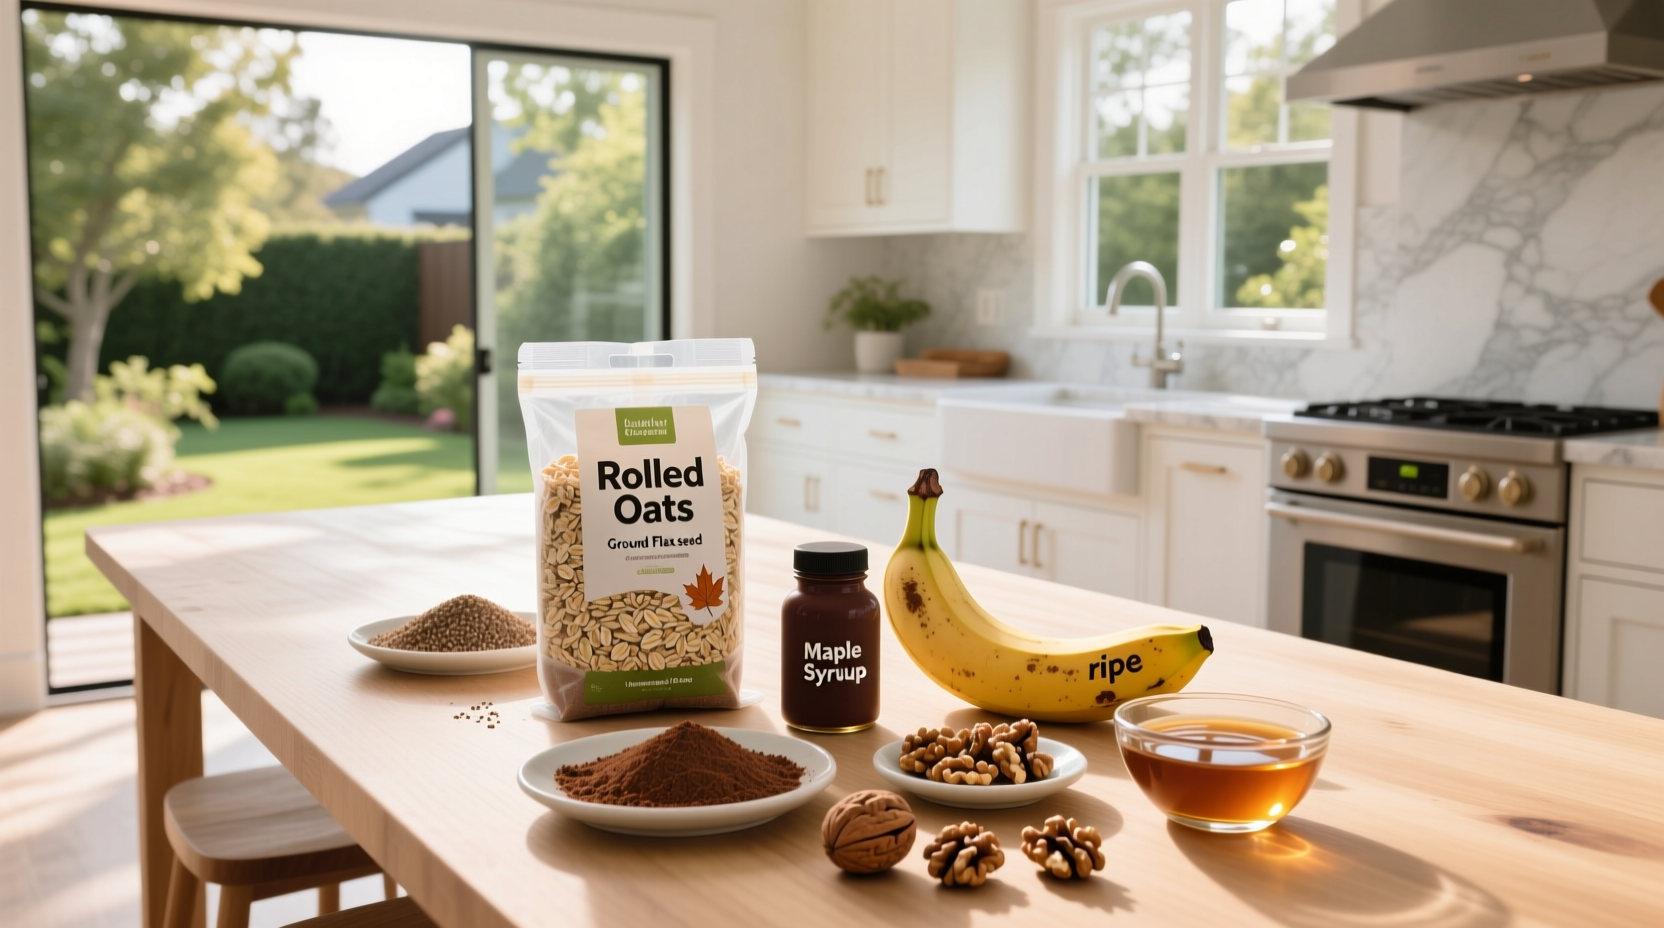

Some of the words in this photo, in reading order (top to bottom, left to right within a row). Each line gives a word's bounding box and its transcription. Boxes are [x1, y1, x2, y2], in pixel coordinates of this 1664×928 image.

[597, 456, 704, 490] Rolled
[614, 494, 694, 524] Oats
[607, 536, 649, 550] Ground
[804, 640, 862, 665] Maple
[1089, 654, 1143, 684] ripe
